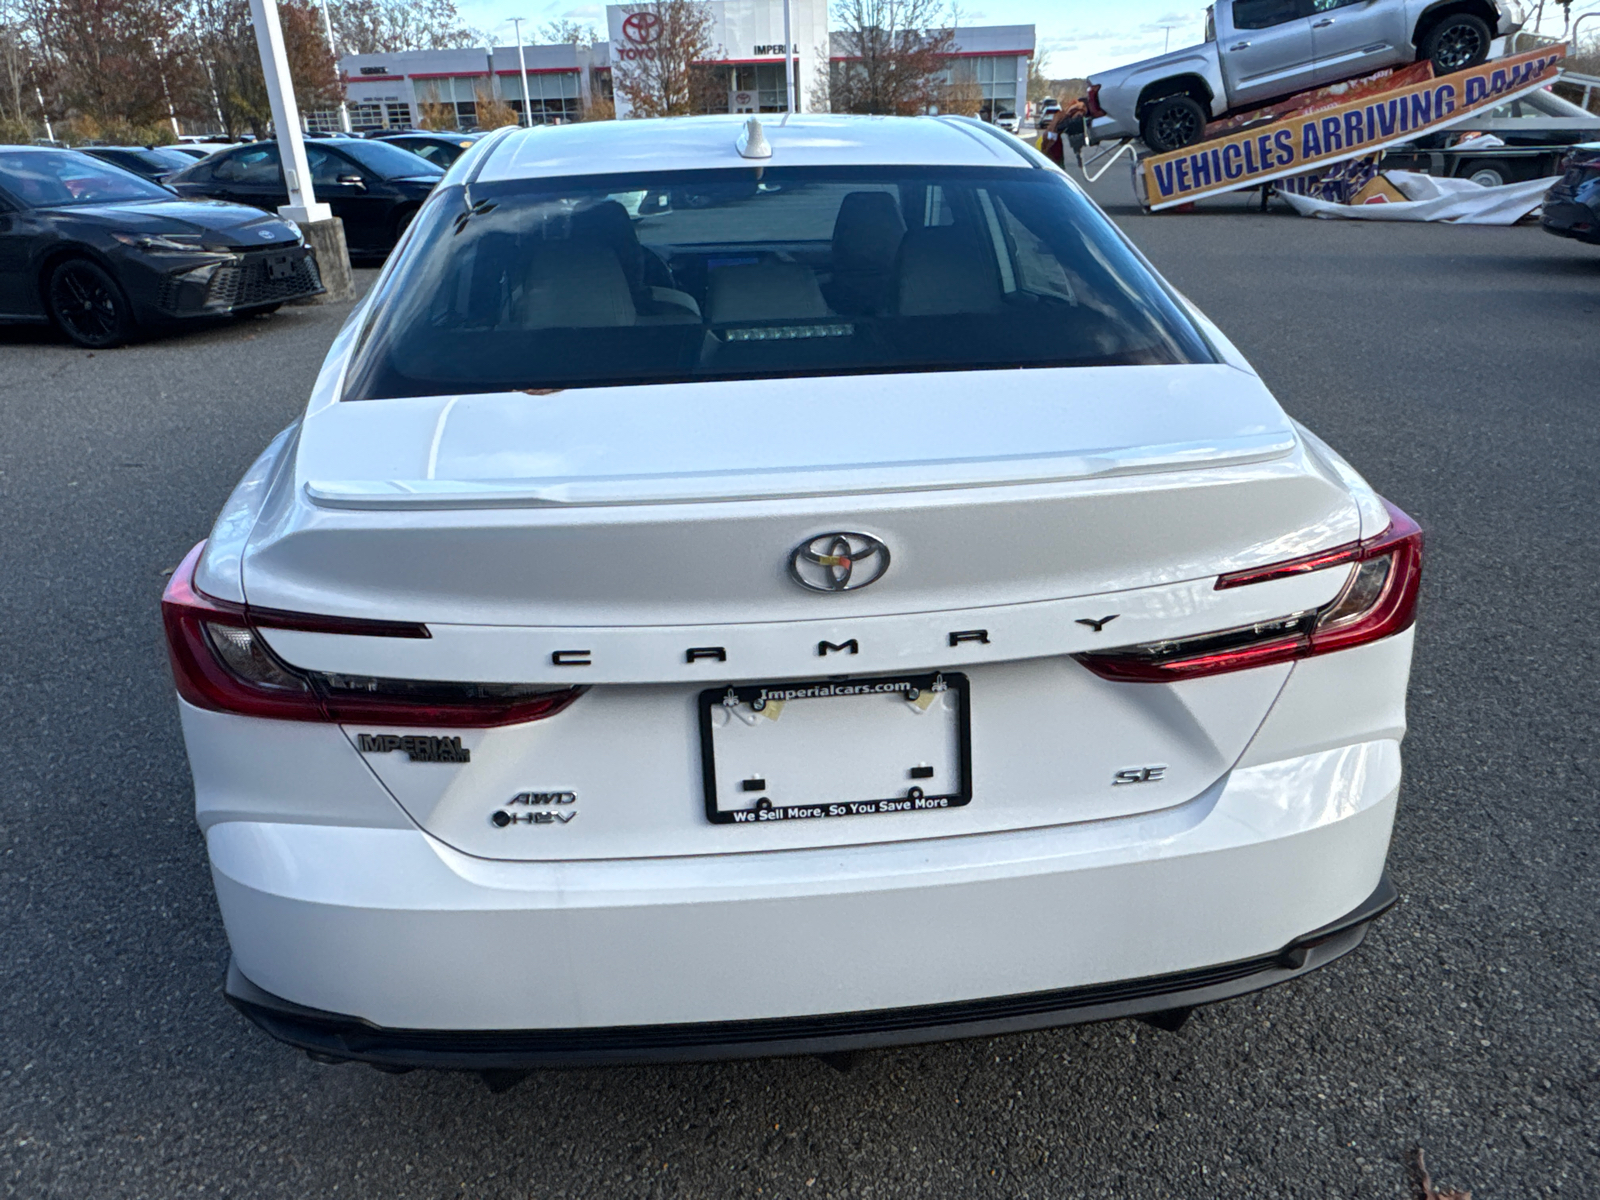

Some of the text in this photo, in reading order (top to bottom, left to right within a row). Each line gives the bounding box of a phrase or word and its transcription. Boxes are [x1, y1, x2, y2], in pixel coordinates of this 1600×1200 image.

[615, 47, 668, 61] TOYO
[753, 44, 800, 56] IMPERIL
[1153, 129, 1295, 197] VEHICLES
[1303, 83, 1455, 160] ARRIVING
[551, 614, 1121, 666] CAMRY
[760, 681, 911, 702] Imperialcars.com
[358, 734, 468, 754] IMPERIAL
[1111, 763, 1169, 786] SE
[506, 791, 578, 806] AWD
[511, 810, 578, 825] HEV
[733, 797, 949, 823] We Sell More, So You Save More
